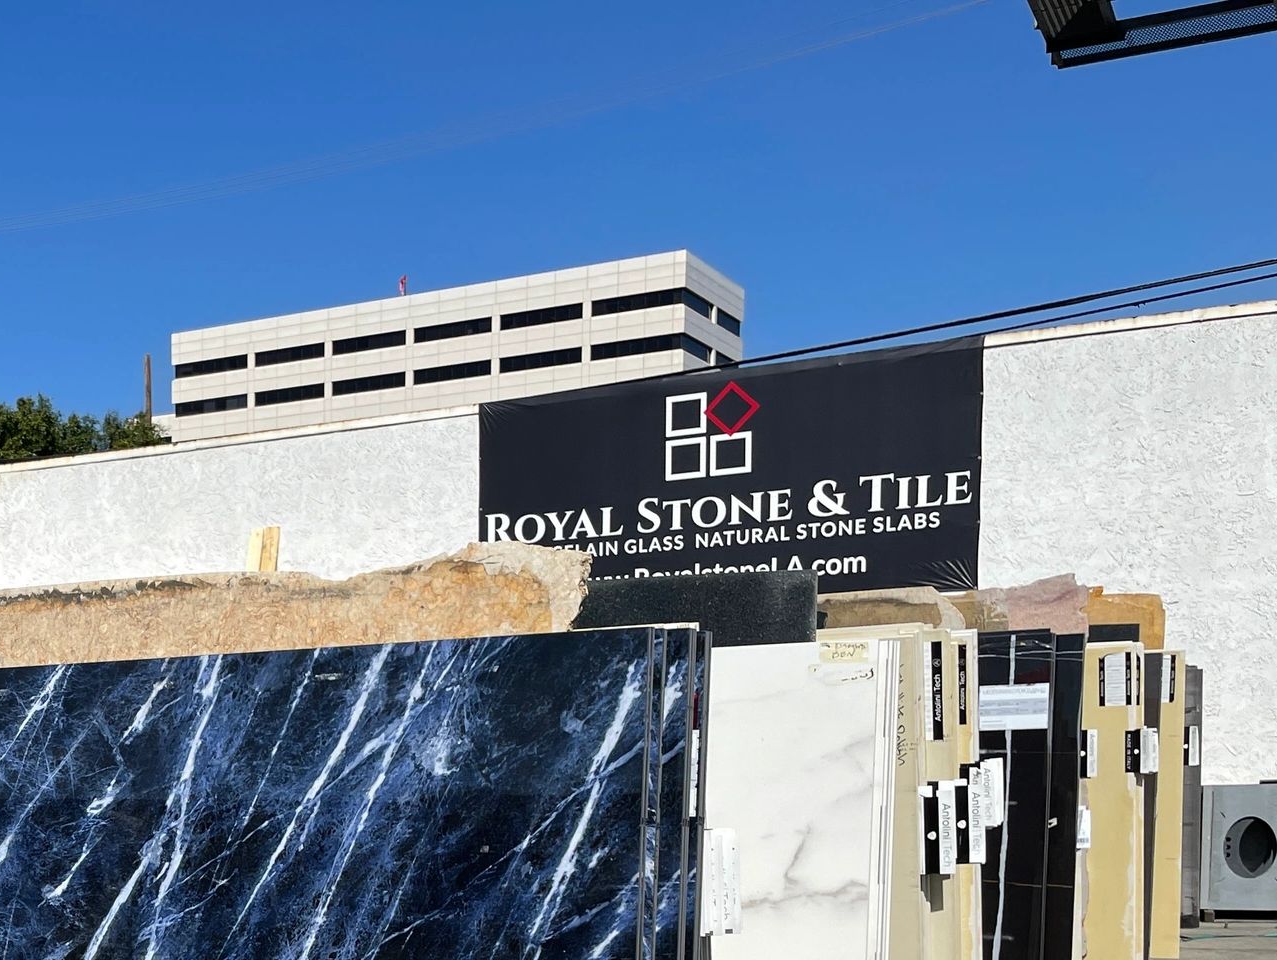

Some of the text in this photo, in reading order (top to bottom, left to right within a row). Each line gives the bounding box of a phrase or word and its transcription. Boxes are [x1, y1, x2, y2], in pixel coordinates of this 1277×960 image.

[485, 470, 973, 544] ROYAL STONE & TILE
[624, 535, 684, 554] GLASS
[695, 526, 790, 549] NATURAL
[796, 517, 866, 541] STONE
[872, 511, 941, 533] SLABS
[587, 555, 867, 581] RlstoneLAcom
[933, 674, 941, 691] Tech
[972, 792, 981, 828] Antolini
[941, 803, 953, 868] Antolini Tech
